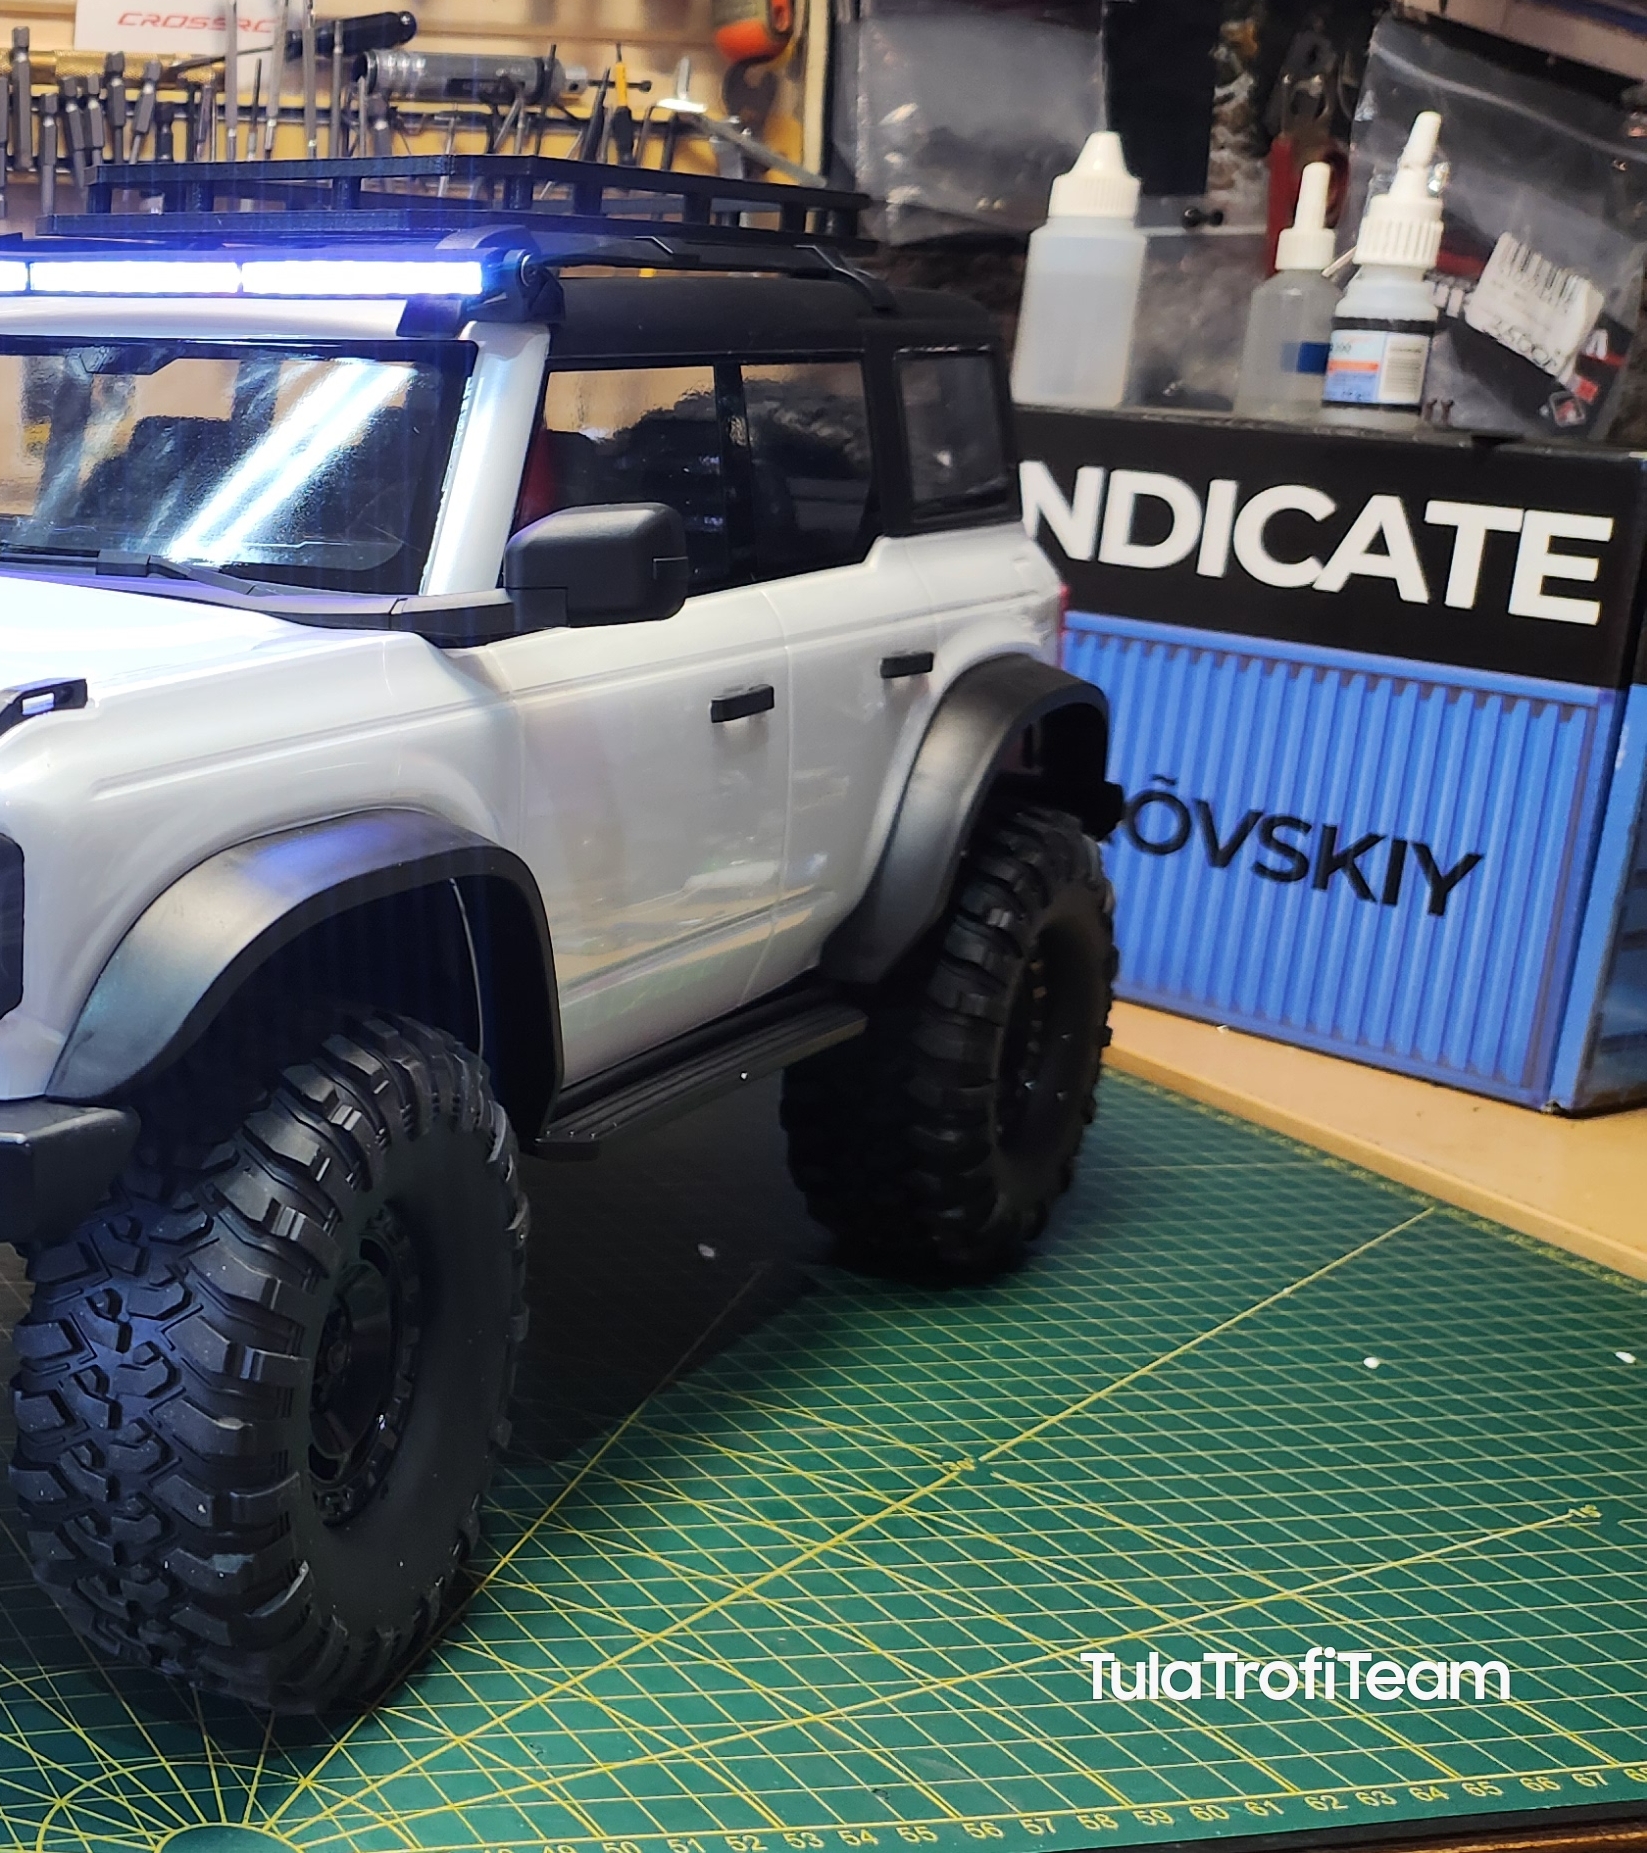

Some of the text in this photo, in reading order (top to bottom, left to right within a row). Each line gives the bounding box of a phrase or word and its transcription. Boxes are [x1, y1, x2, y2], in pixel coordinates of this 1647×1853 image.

[1122, 773, 1485, 917] ÕVSKIY
[666, 1836, 706, 1853] 51
[723, 1834, 768, 1852] 52
[783, 1830, 825, 1849] 53
[837, 1828, 880, 1846] 54
[895, 1826, 939, 1843] 55
[961, 1821, 1005, 1840] 56
[1019, 1816, 1057, 1836] 57
[1075, 1813, 1119, 1831] 58
[1132, 1808, 1175, 1826] 59
[1188, 1804, 1230, 1821] 60
[1243, 1799, 1285, 1817] 61
[1303, 1794, 1350, 1811] 62
[1354, 1790, 1398, 1807] 63
[1407, 1785, 1450, 1802] 64
[1460, 1780, 1505, 1798] 65
[1518, 1776, 1562, 1793] 66
[1571, 1771, 1609, 1788] 67
